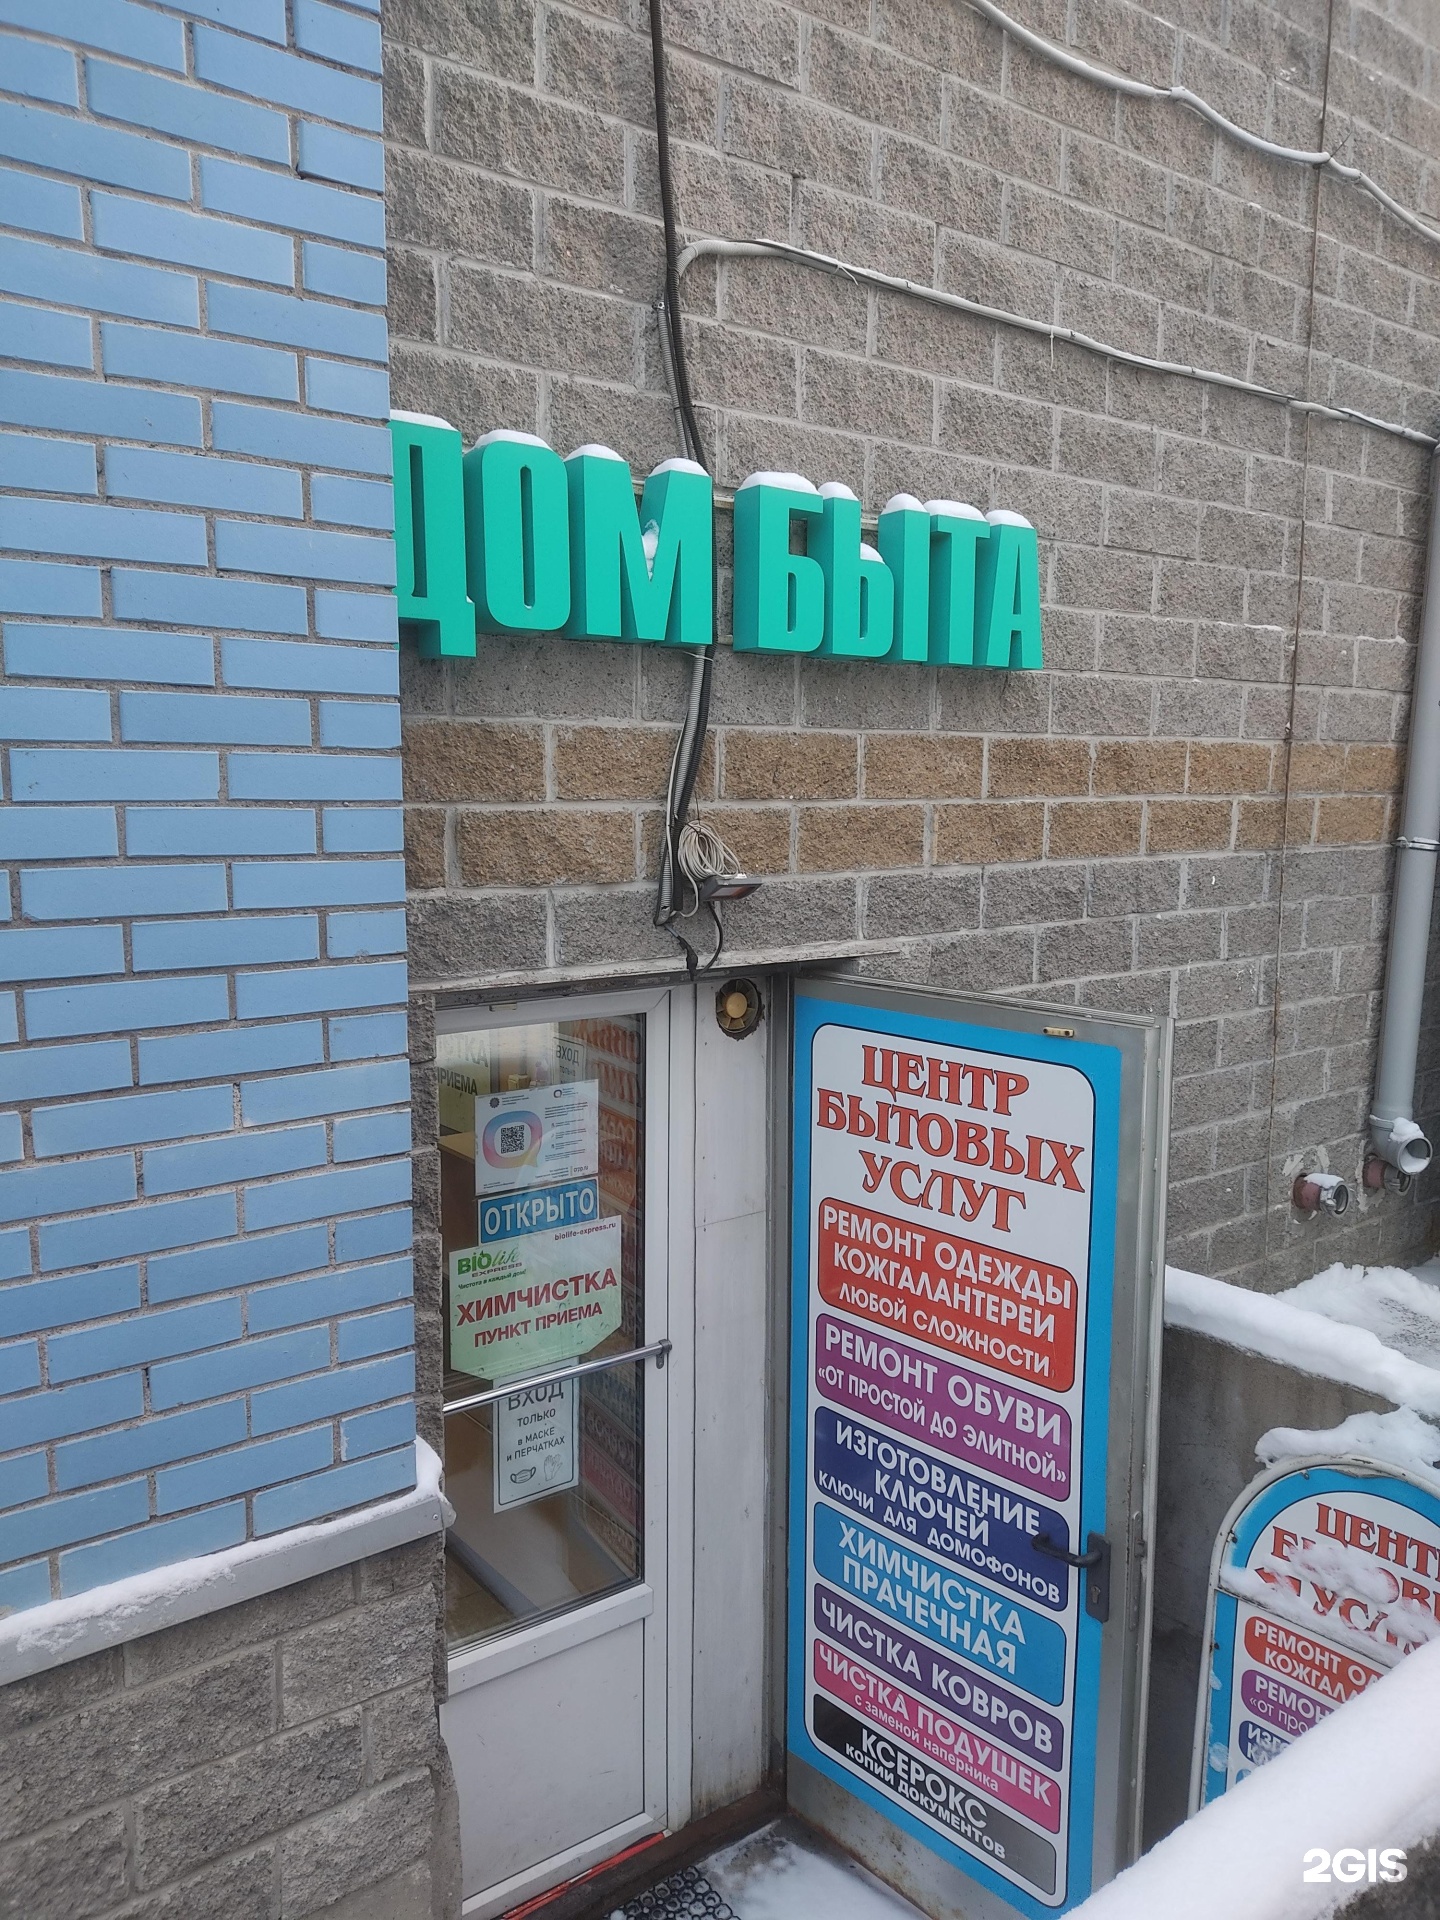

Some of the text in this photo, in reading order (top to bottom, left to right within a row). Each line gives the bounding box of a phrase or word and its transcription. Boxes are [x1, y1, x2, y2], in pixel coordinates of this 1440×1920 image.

[390, 418, 1042, 670] ДОМ БЫТА
[861, 1044, 1030, 1117] ЦЕНТР
[816, 1087, 1086, 1194] БЫТОВЫХ
[484, 1187, 595, 1236] ОТКРЫТО
[554, 1221, 616, 1241] biolife-express.ru
[858, 1149, 1027, 1233] УСЛУГ
[456, 1267, 618, 1327] ХИМЧИСТКА
[471, 1261, 523, 1279] EXPRESS
[822, 1205, 1071, 1309] РЕМОНТ ОДЕЖДЫ
[833, 1241, 1056, 1344] КОЖГАЛАНТЕРЕИ
[474, 1302, 603, 1348] ПУНКТ ПРИЕМА
[838, 1283, 1050, 1378] ЛЮБОЙ СЛОЖНОСТИ
[508, 1383, 564, 1412] ВХОД
[517, 1408, 556, 1428] ТОЛЬКО
[817, 1364, 1067, 1484] «ОТ ПРОСТОЙ ДО ЭЛИТНОЙ»
[825, 1322, 1062, 1446] РЕМОНТ ОБУВИ
[514, 1435, 565, 1460] ПЕРЧАТКАХ
[525, 1426, 556, 1445] МАСКЕ
[836, 1420, 1041, 1537] ИЗГОТОВЛЕНИЕ
[818, 1469, 1061, 1605] КЛЮЧИ ДЛЯ ДОМОФОНОВ
[874, 1468, 990, 1547] КЛЮЧЕЙ
[838, 1521, 1027, 1645] ХИМЧИСТКА
[843, 1555, 1017, 1676] ПРАЧЕЧНАЯ
[820, 1597, 1054, 1755] ЧИСТКА КОВРОВ
[1254, 1620, 1342, 1675] РЕМОНТ
[818, 1643, 1053, 1807] ЧИСТКА ПОДУШЕК
[864, 1699, 920, 1744] заменой
[923, 1736, 1000, 1793] наперника
[861, 1727, 988, 1830] КСЕРОКС
